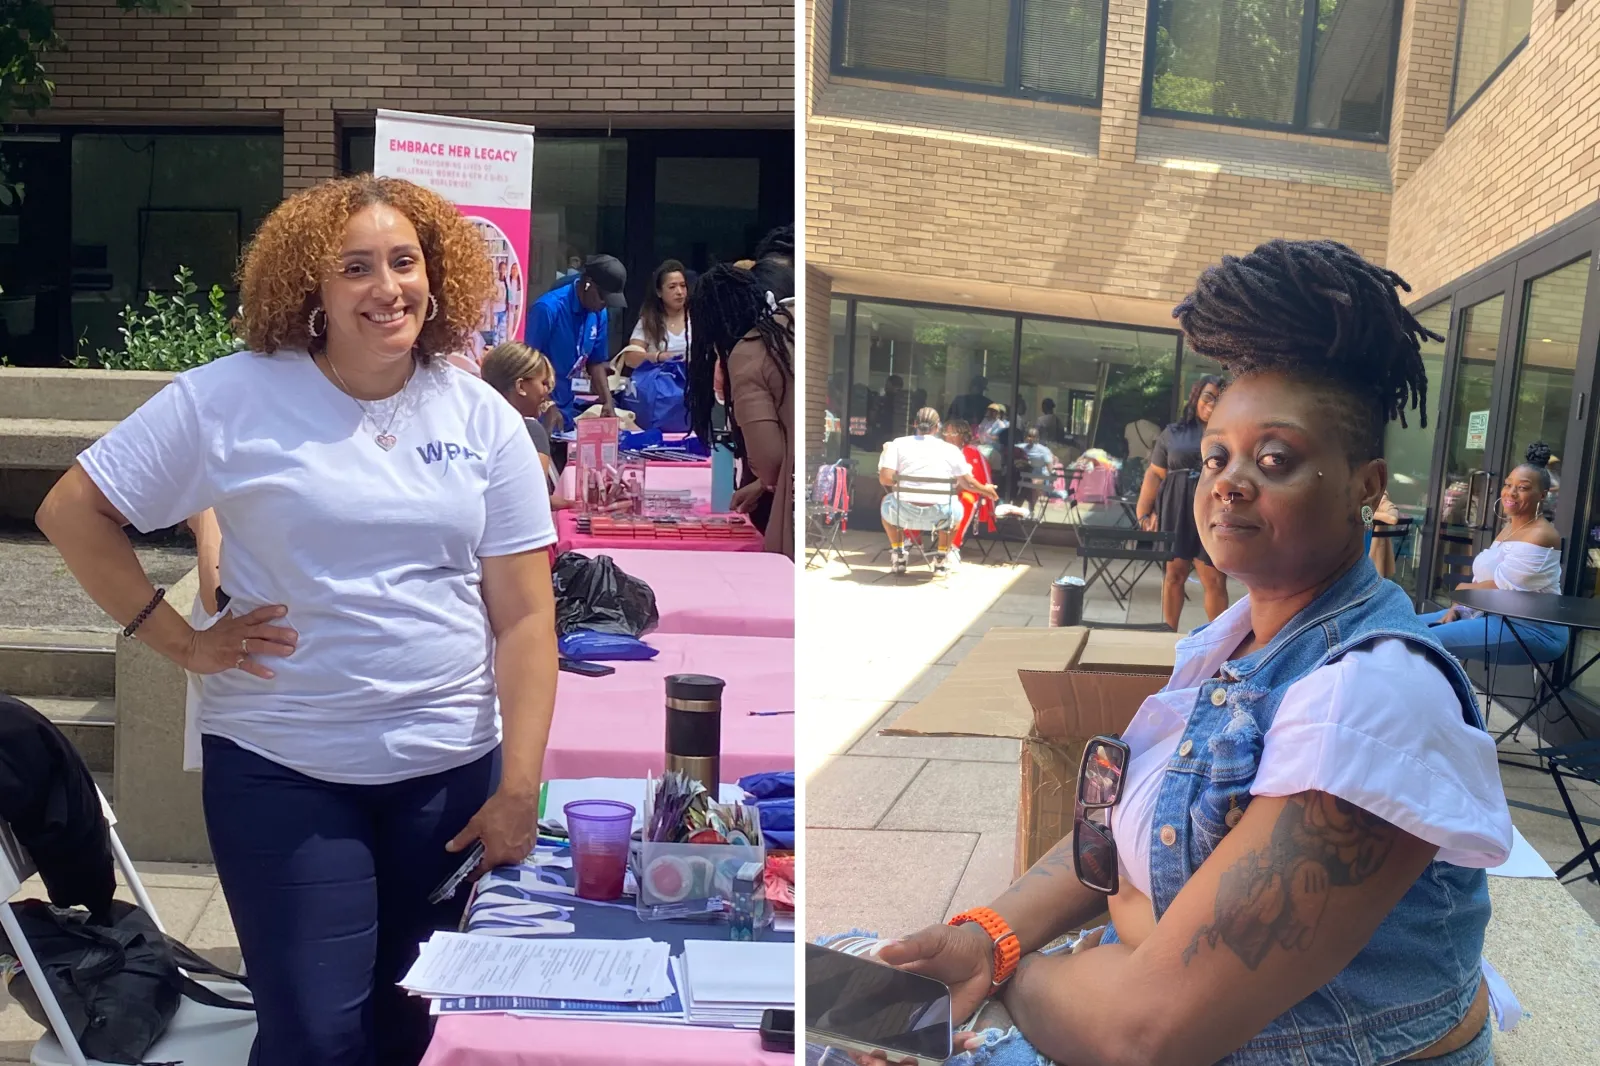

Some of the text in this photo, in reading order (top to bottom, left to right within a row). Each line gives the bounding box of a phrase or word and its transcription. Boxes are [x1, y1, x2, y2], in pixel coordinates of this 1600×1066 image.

[389, 138, 517, 163] EMBRACE HER LEGACY
[416, 440, 482, 465] WPA
